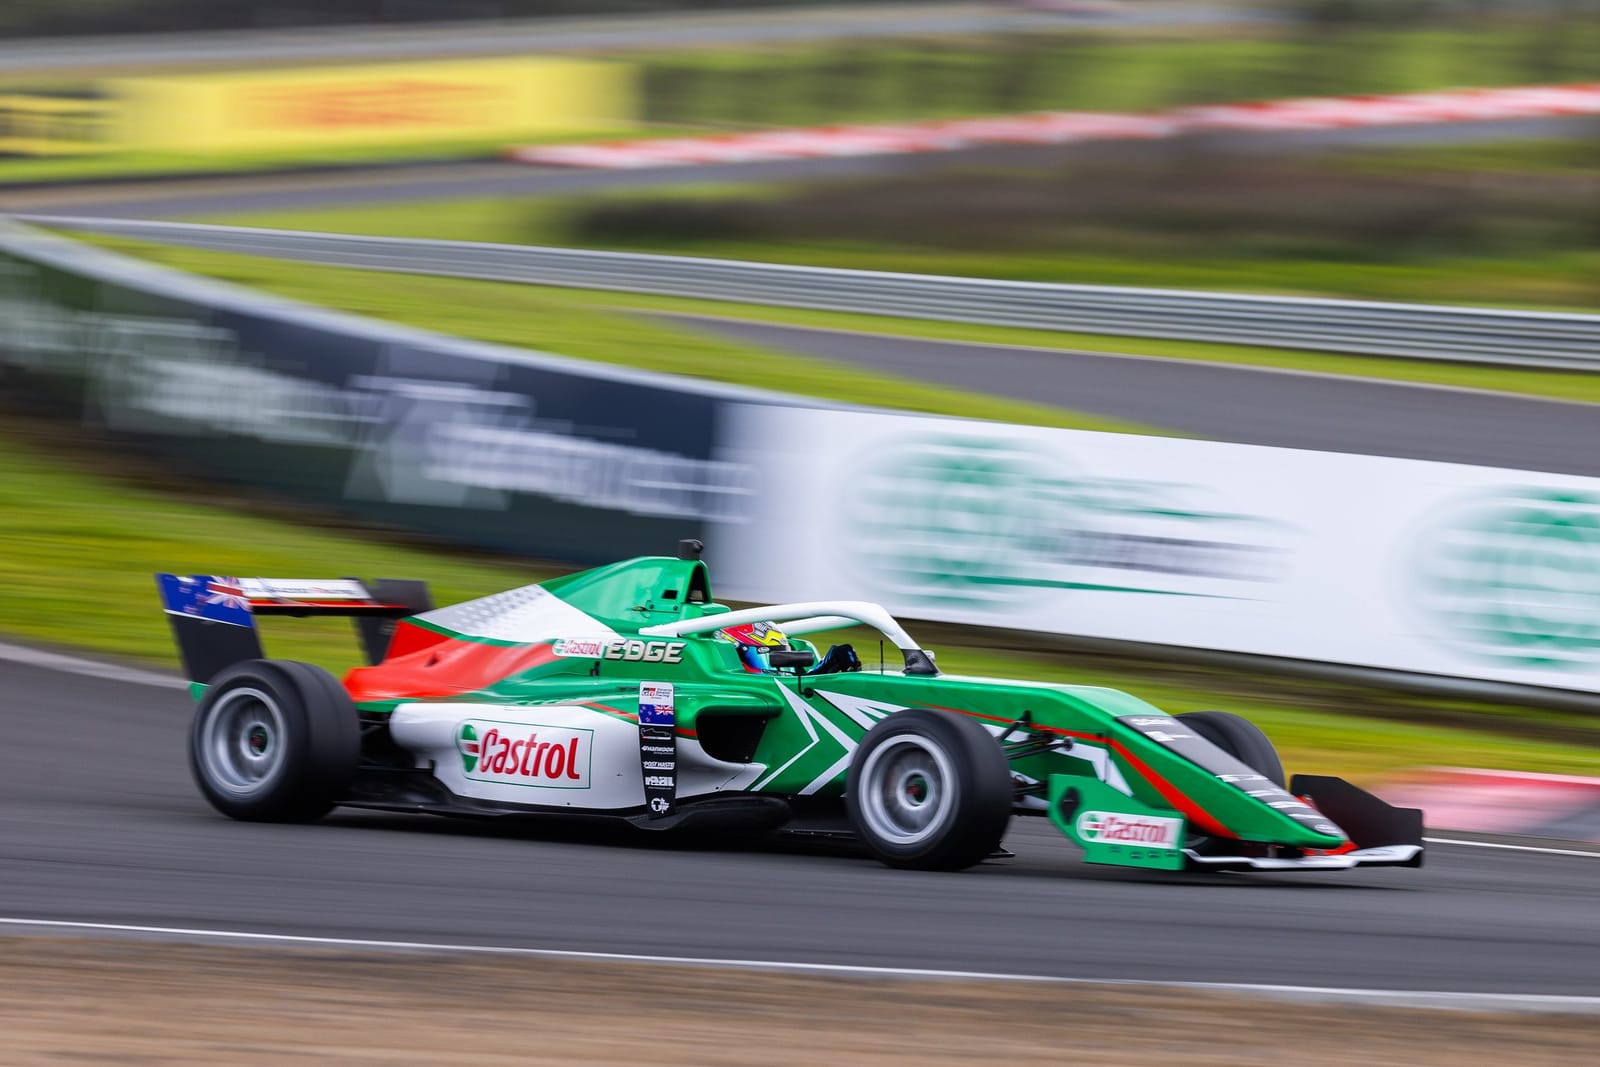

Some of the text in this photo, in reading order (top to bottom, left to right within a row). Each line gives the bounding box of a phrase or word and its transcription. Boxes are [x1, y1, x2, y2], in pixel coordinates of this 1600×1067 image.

[564, 639, 686, 663] Castrol EDGE
[480, 728, 580, 780] Castrol
[1103, 816, 1170, 844] Castrol
